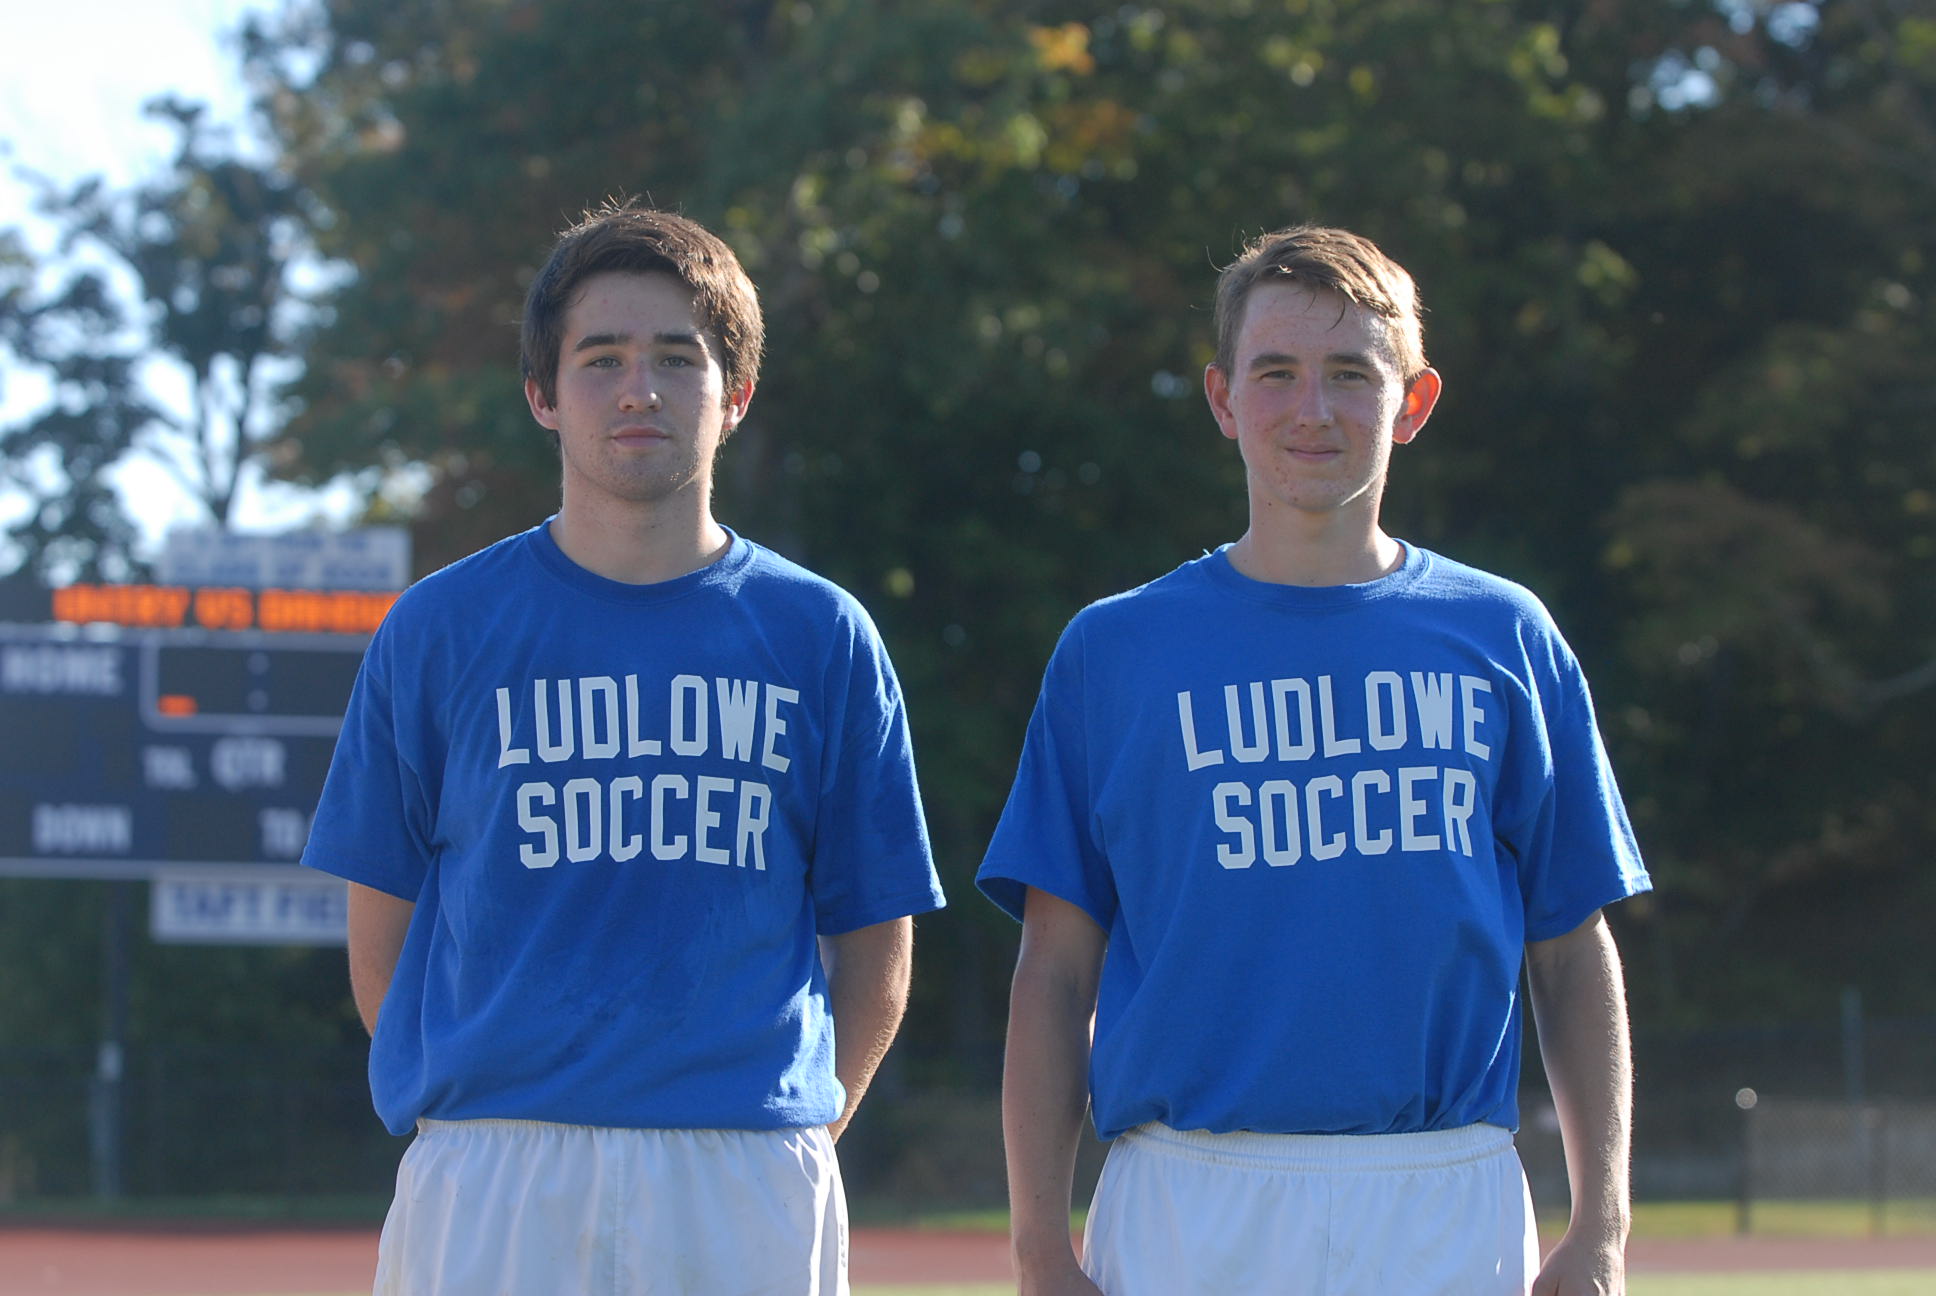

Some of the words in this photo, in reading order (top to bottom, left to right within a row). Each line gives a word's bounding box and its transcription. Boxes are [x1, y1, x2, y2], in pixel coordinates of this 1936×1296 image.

[2, 645, 121, 693] HOME
[210, 737, 286, 790] QTR
[496, 674, 799, 773] LUDLOWE
[1177, 671, 1492, 772] LUDLOWE
[33, 805, 132, 853] DOWN
[517, 774, 772, 871] SOCCER
[1212, 766, 1476, 870] SOCCER
